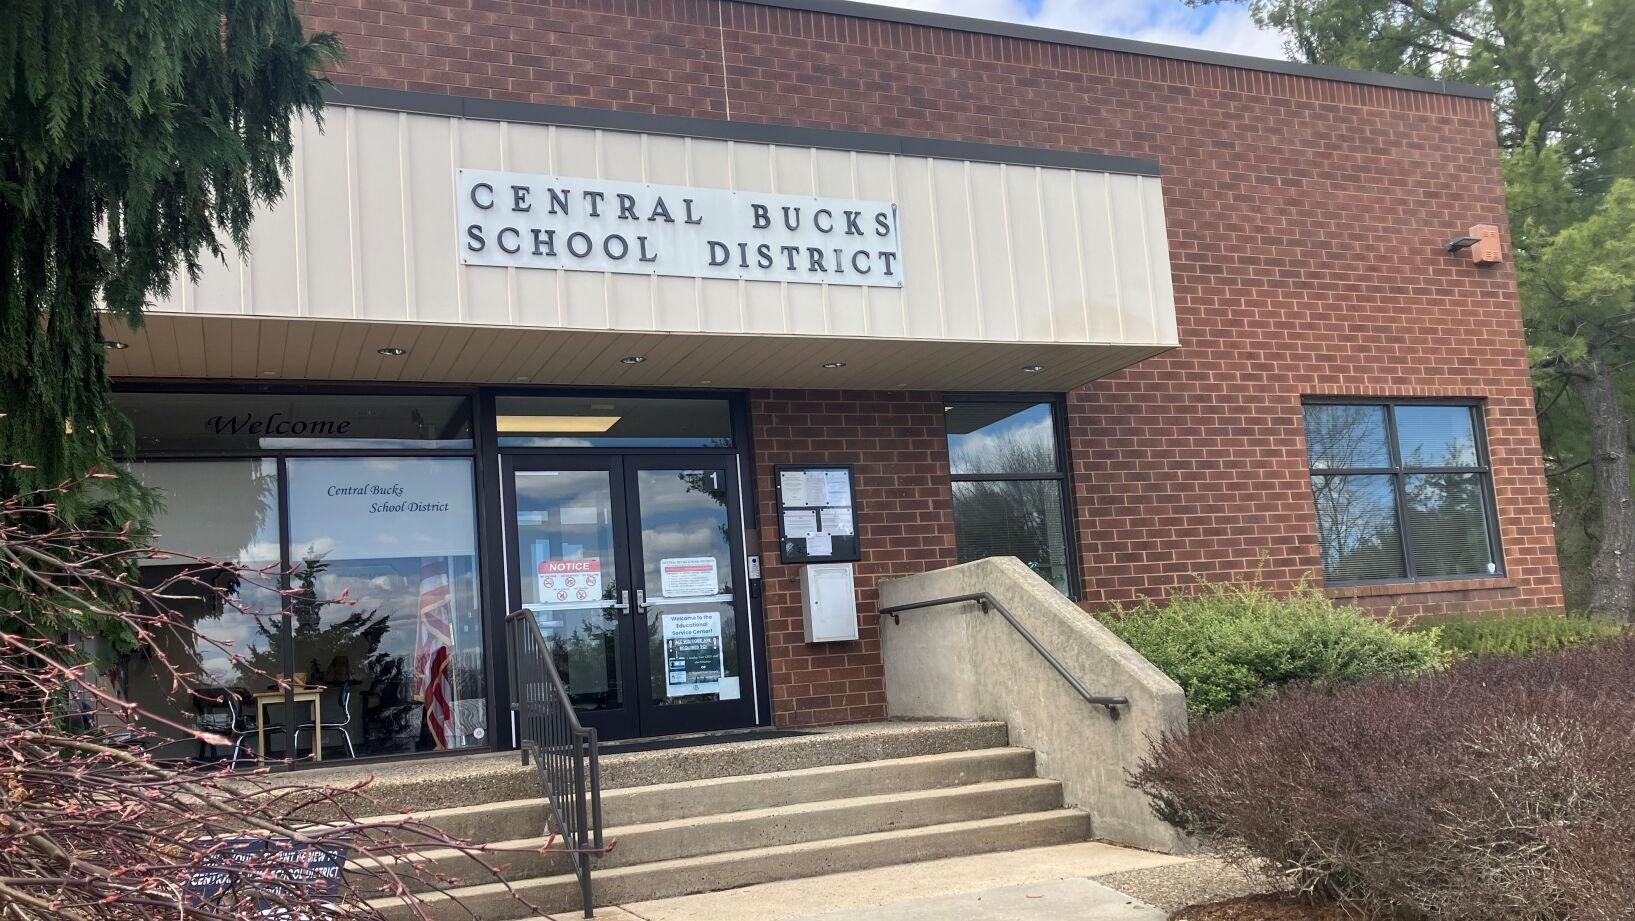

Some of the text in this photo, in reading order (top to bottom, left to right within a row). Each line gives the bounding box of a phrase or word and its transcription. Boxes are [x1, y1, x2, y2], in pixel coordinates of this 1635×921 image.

[470, 182, 890, 237] CENTRAL BUCKS
[467, 224, 897, 276] SCHOOL DISTRICT
[207, 413, 351, 435] Welcome
[710, 471, 718, 489] 1
[327, 484, 404, 497] Central Bucks
[369, 500, 449, 514] School District
[549, 562, 590, 572] NOTICE
[191, 872, 240, 886] CENTRA
